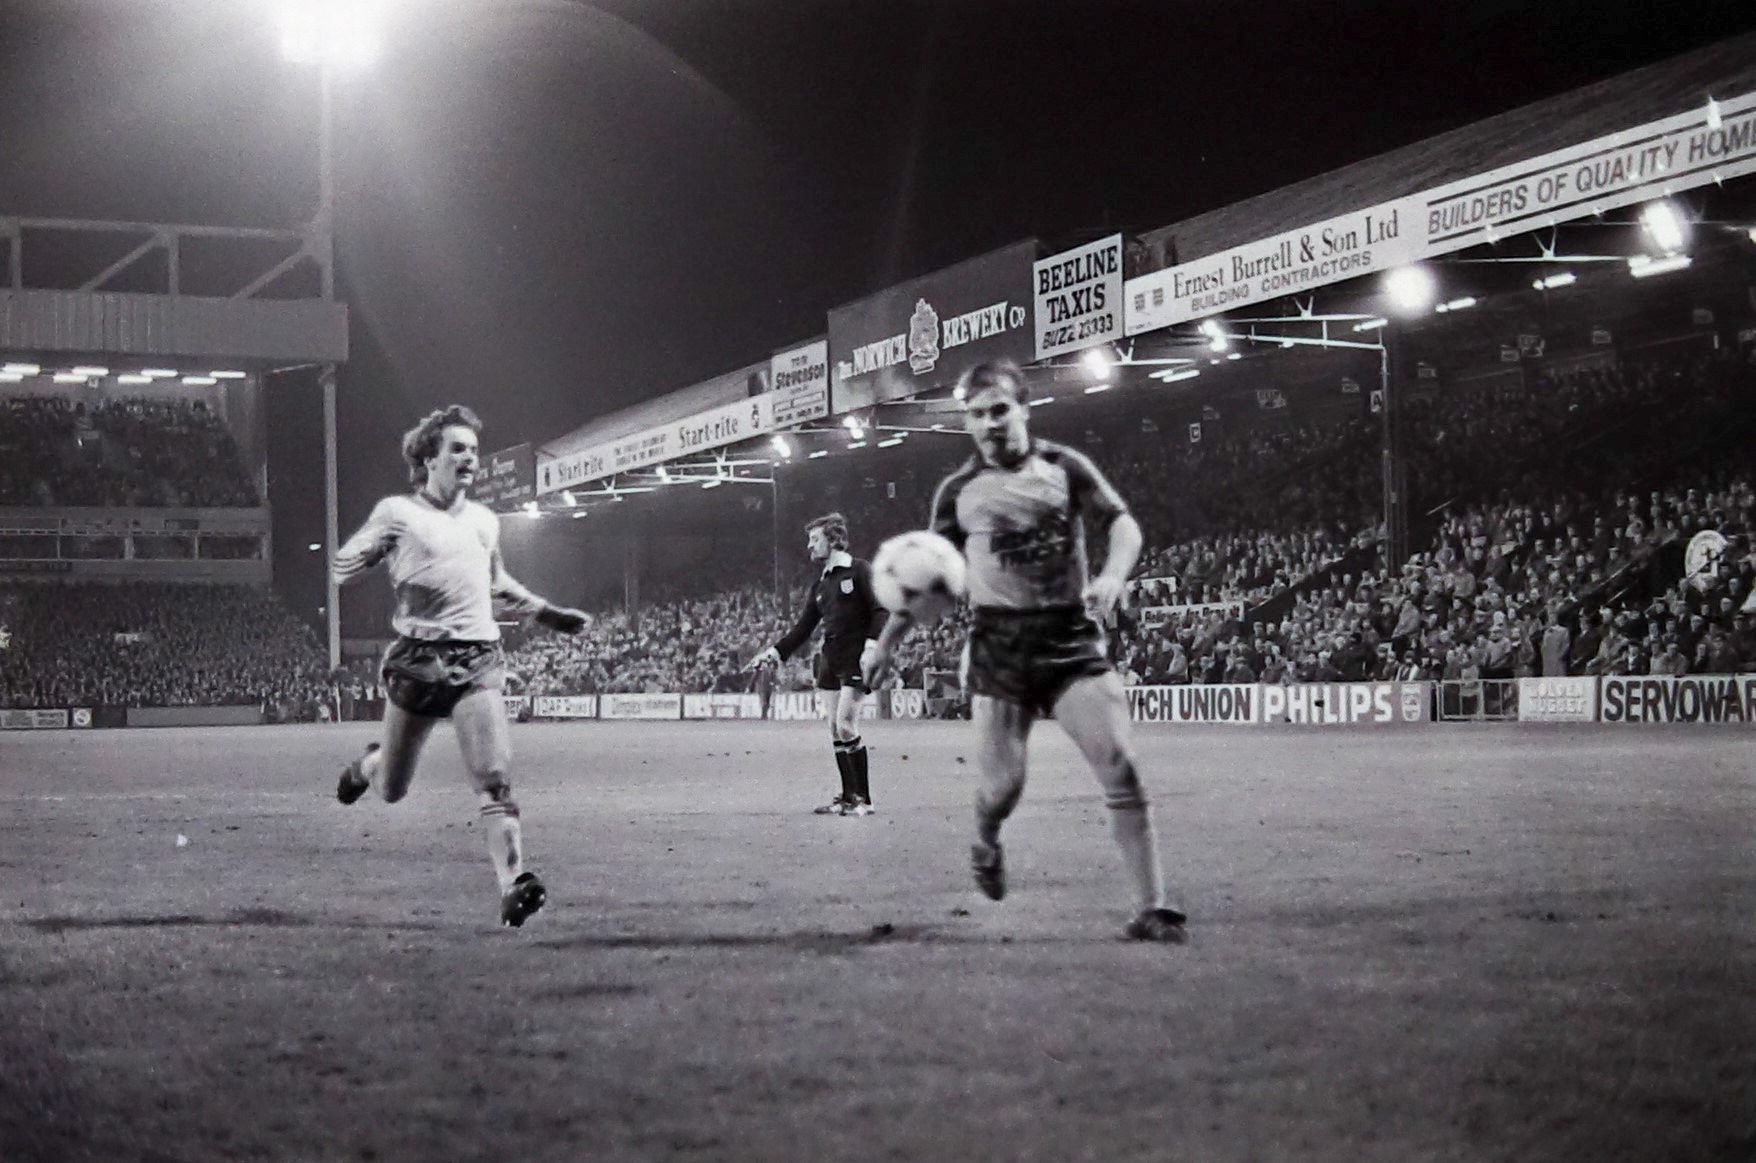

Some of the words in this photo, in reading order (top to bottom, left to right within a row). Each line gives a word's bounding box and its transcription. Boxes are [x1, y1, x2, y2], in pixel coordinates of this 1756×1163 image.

[1428, 184, 1528, 234] BUILDERS
[1537, 173, 1568, 203] OF
[1038, 245, 1118, 295] BEELINE
[1174, 266, 1225, 298] Ernest
[1232, 241, 1292, 282] Burrell
[1300, 234, 1315, 262] &
[1321, 229, 1358, 257] Son
[1366, 209, 1399, 244] Ltd
[1046, 284, 1106, 324] TAXIS
[1191, 287, 1250, 313] BUILDING
[1261, 251, 1372, 292] CONTRACTORS
[852, 333, 907, 376] NORWICH
[942, 301, 1008, 349] BREWERY
[1043, 325, 1076, 350] BUZZ
[1179, 687, 1251, 721] UNION
[1264, 684, 1393, 724] PHILIPS
